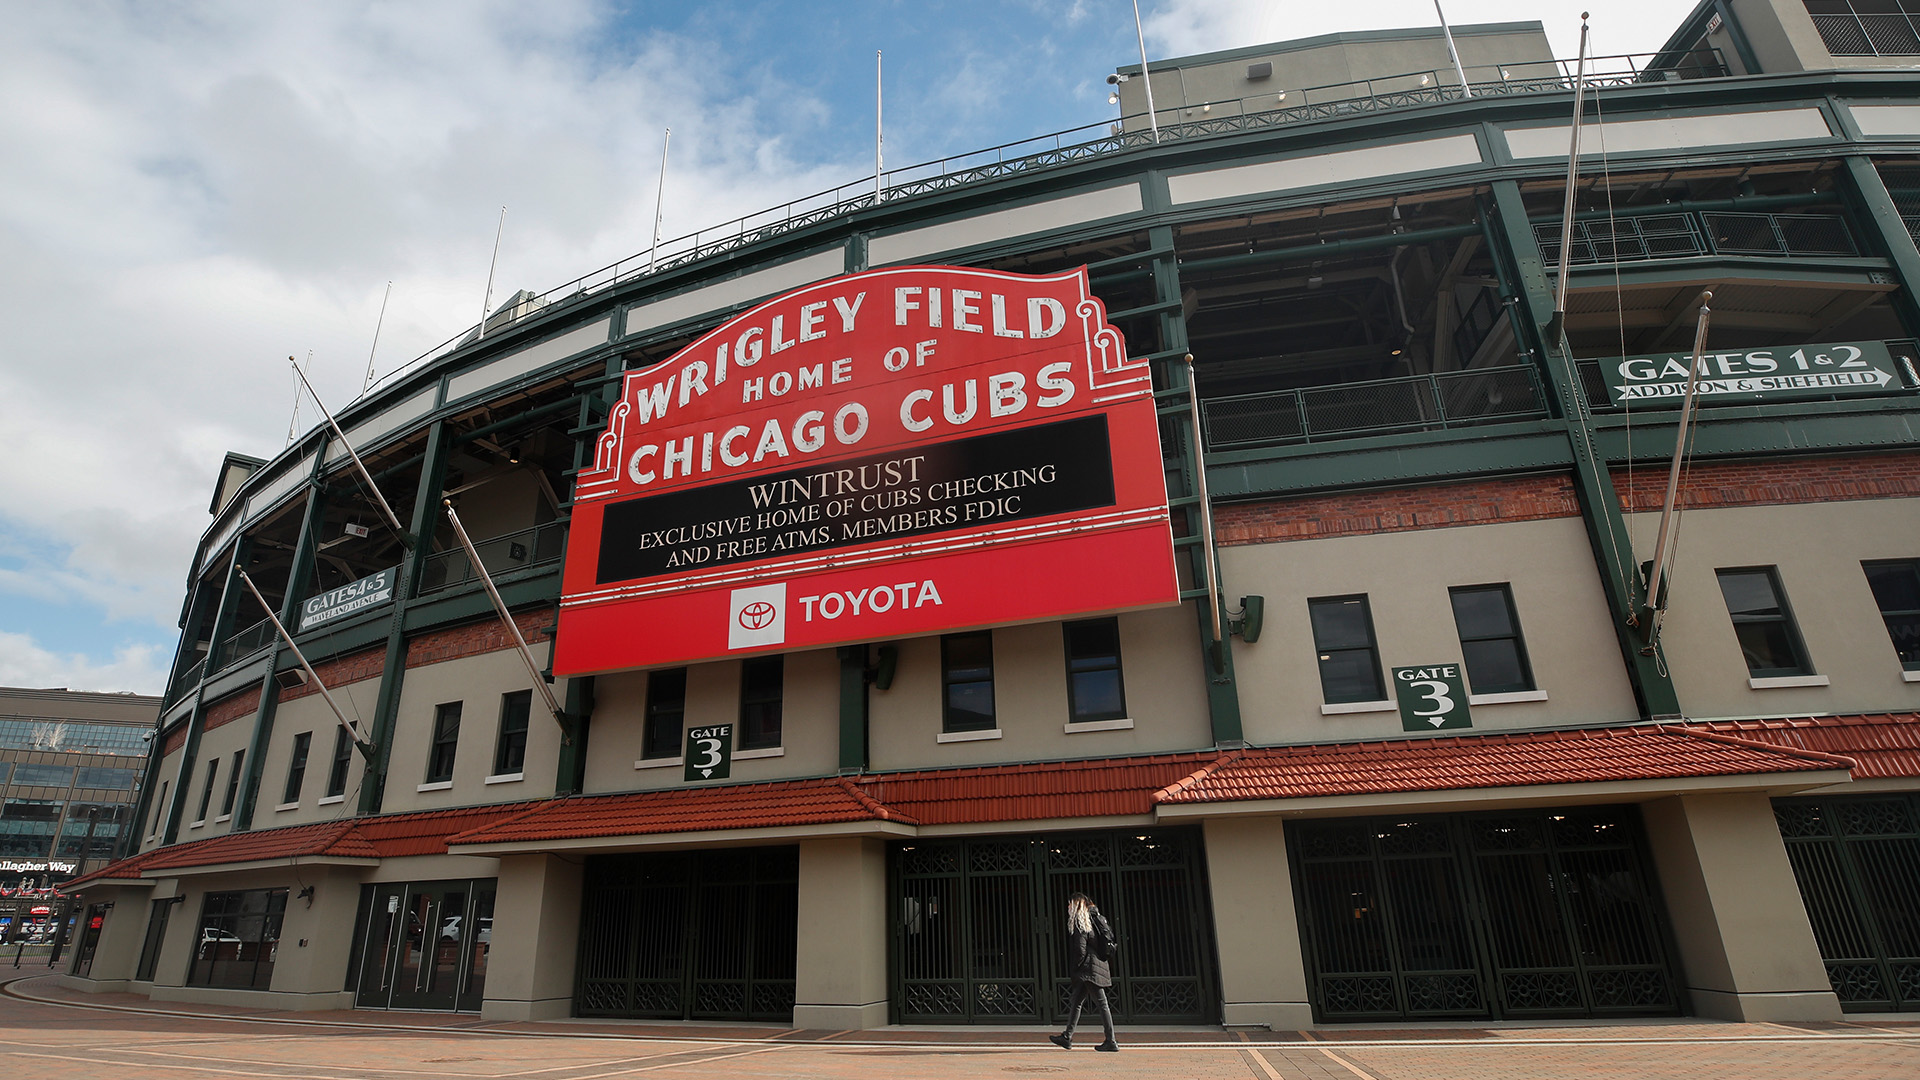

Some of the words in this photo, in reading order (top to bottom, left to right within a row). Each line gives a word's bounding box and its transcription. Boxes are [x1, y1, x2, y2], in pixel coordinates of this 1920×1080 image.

[637, 291, 867, 425] WRIGLEY
[895, 286, 1066, 339] FIELD
[743, 357, 852, 404] HOME
[883, 339, 938, 372] OF
[1617, 351, 1778, 381] GATES
[1626, 380, 1729, 399] ADDISON
[1736, 379, 1754, 392] &
[1760, 371, 1879, 389] SHEFFIELD
[628, 401, 869, 485] CHICAGO
[899, 361, 1075, 433] CUBS
[747, 455, 925, 510] WINTRUST
[638, 515, 751, 550] EXCLUSIVE
[756, 503, 821, 531] HOME
[826, 498, 855, 518] OF
[860, 486, 922, 513] CUBS
[927, 464, 1057, 502] CHECKING
[665, 545, 711, 569] AND
[715, 536, 768, 561] FREE
[771, 525, 836, 552] ATMS.
[841, 505, 958, 542] MEMBERS
[963, 495, 1022, 522] FDIC
[306, 583, 358, 614] GATES
[351, 593, 379, 610] AVENUE
[799, 579, 943, 622] TOYOTA
[1397, 666, 1457, 681] GATE
[1410, 680, 1455, 716] 3
[690, 726, 730, 739] GATE
[693, 738, 722, 769] 3
[48, 861, 76, 874] Way
